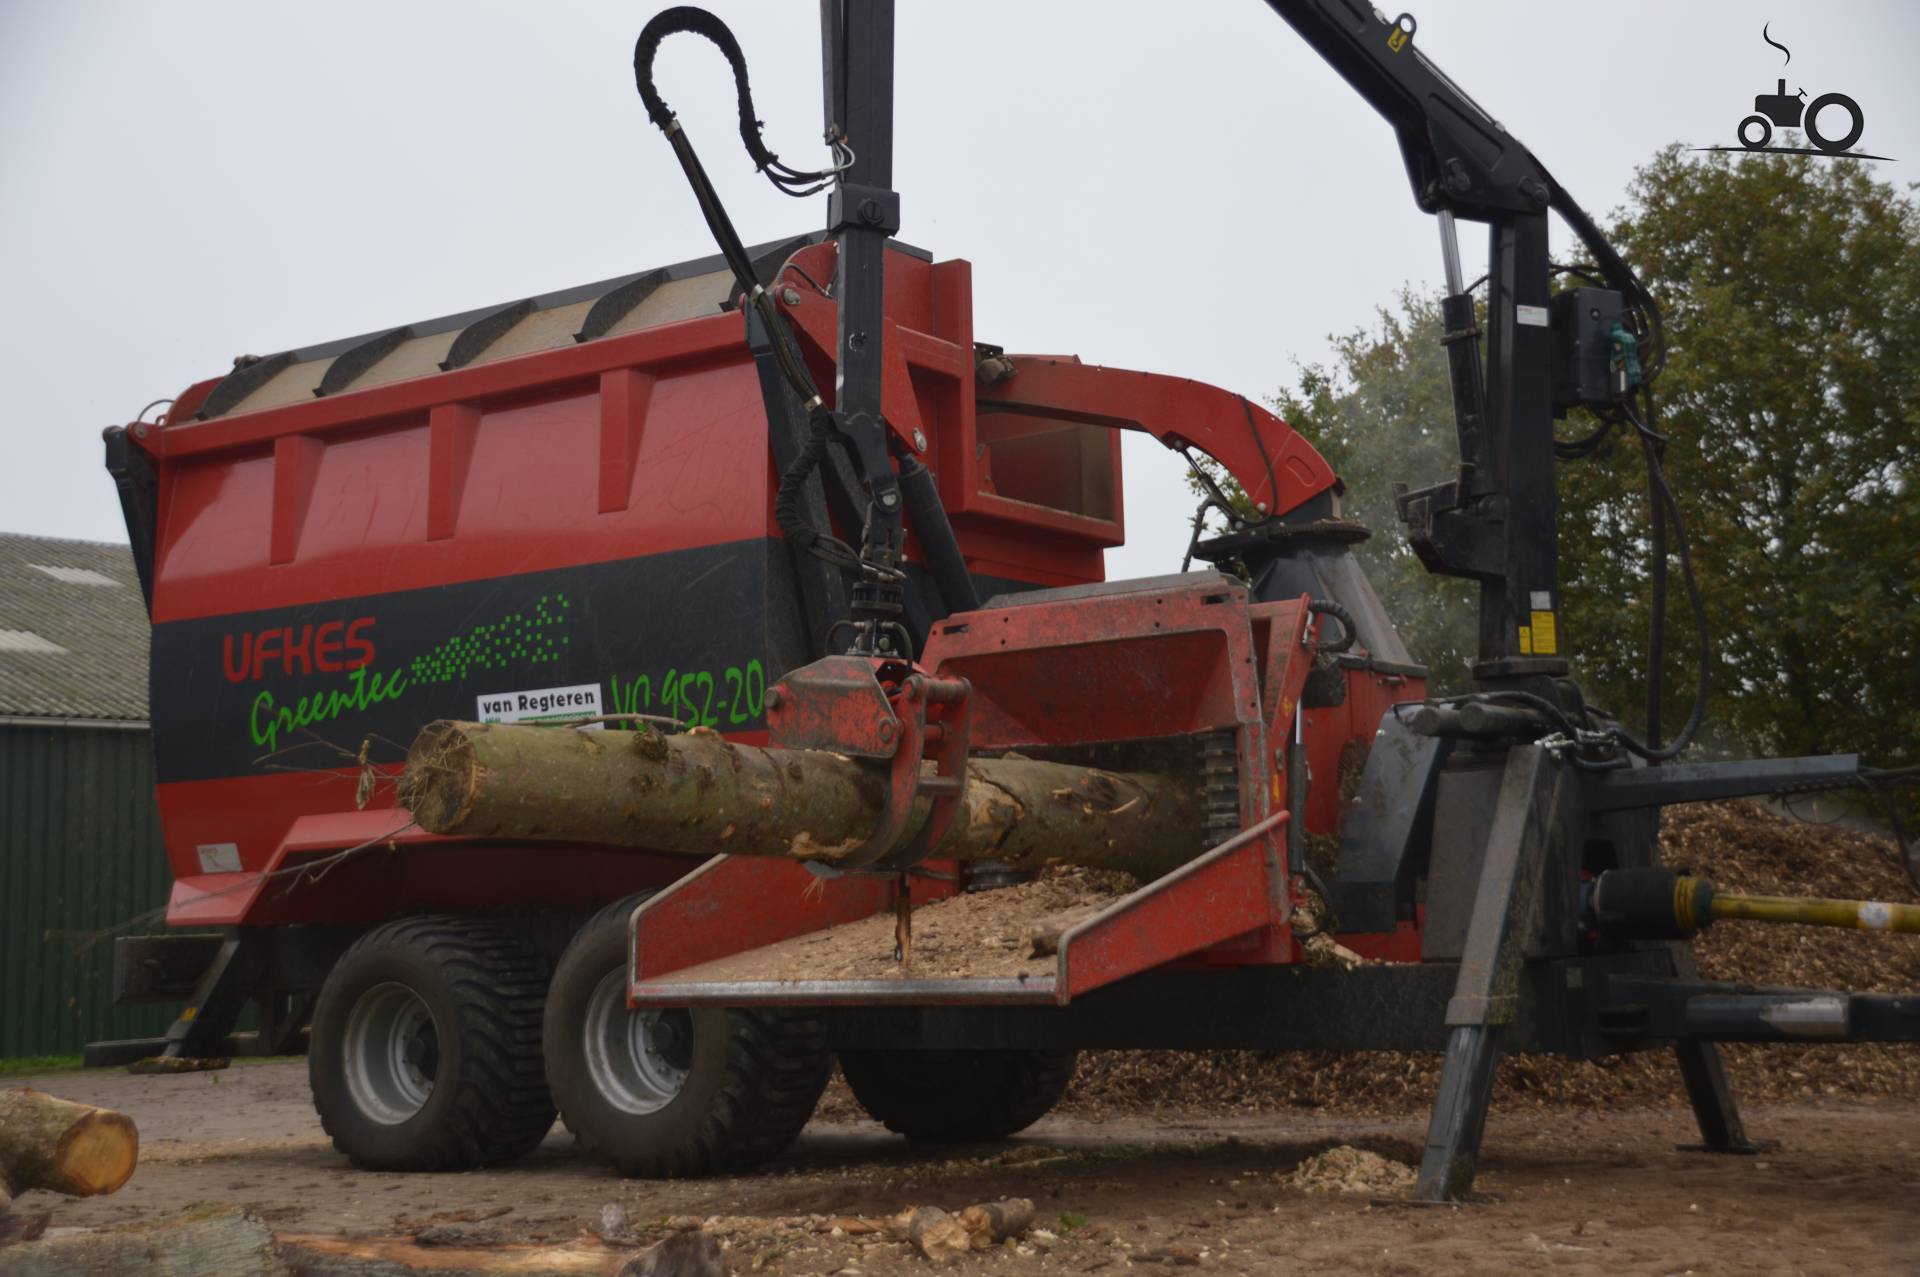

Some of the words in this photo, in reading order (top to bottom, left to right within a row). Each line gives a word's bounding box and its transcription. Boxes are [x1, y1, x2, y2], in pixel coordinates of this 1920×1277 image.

[223, 616, 377, 683] UFKES
[251, 663, 408, 752] Greentec
[483, 699, 513, 714] van
[518, 691, 595, 712] Regteren
[662, 658, 765, 731] 952-20
